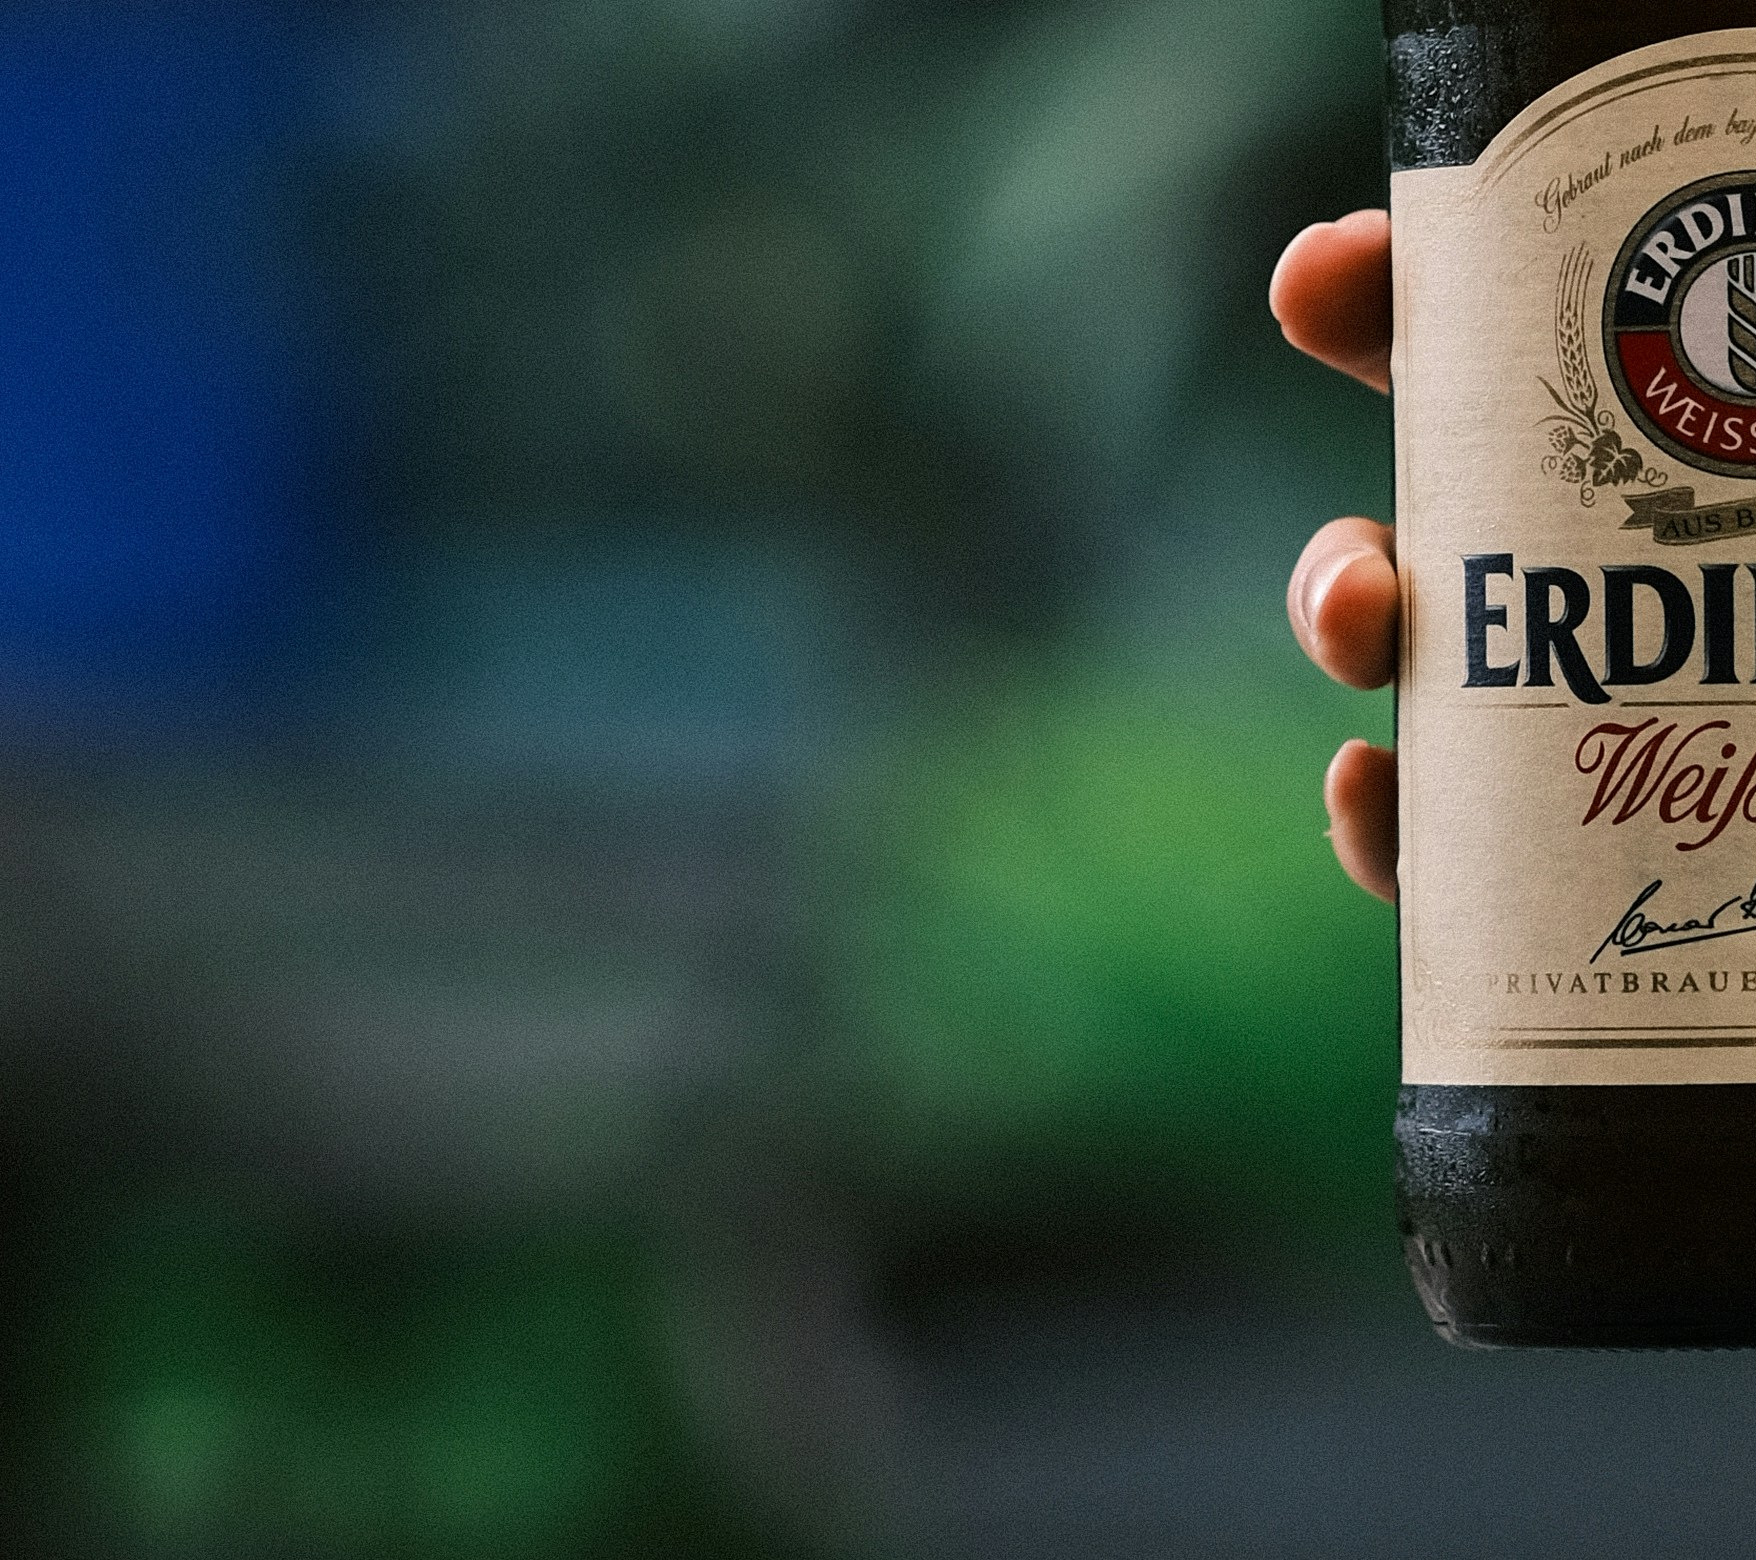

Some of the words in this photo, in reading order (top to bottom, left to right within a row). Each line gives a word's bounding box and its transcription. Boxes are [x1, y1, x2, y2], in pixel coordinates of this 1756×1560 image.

[1535, 152, 1612, 233] Gebraut
[1619, 124, 1665, 169] nach
[1673, 115, 1716, 146] dem
[1661, 513, 1722, 537] AUS
